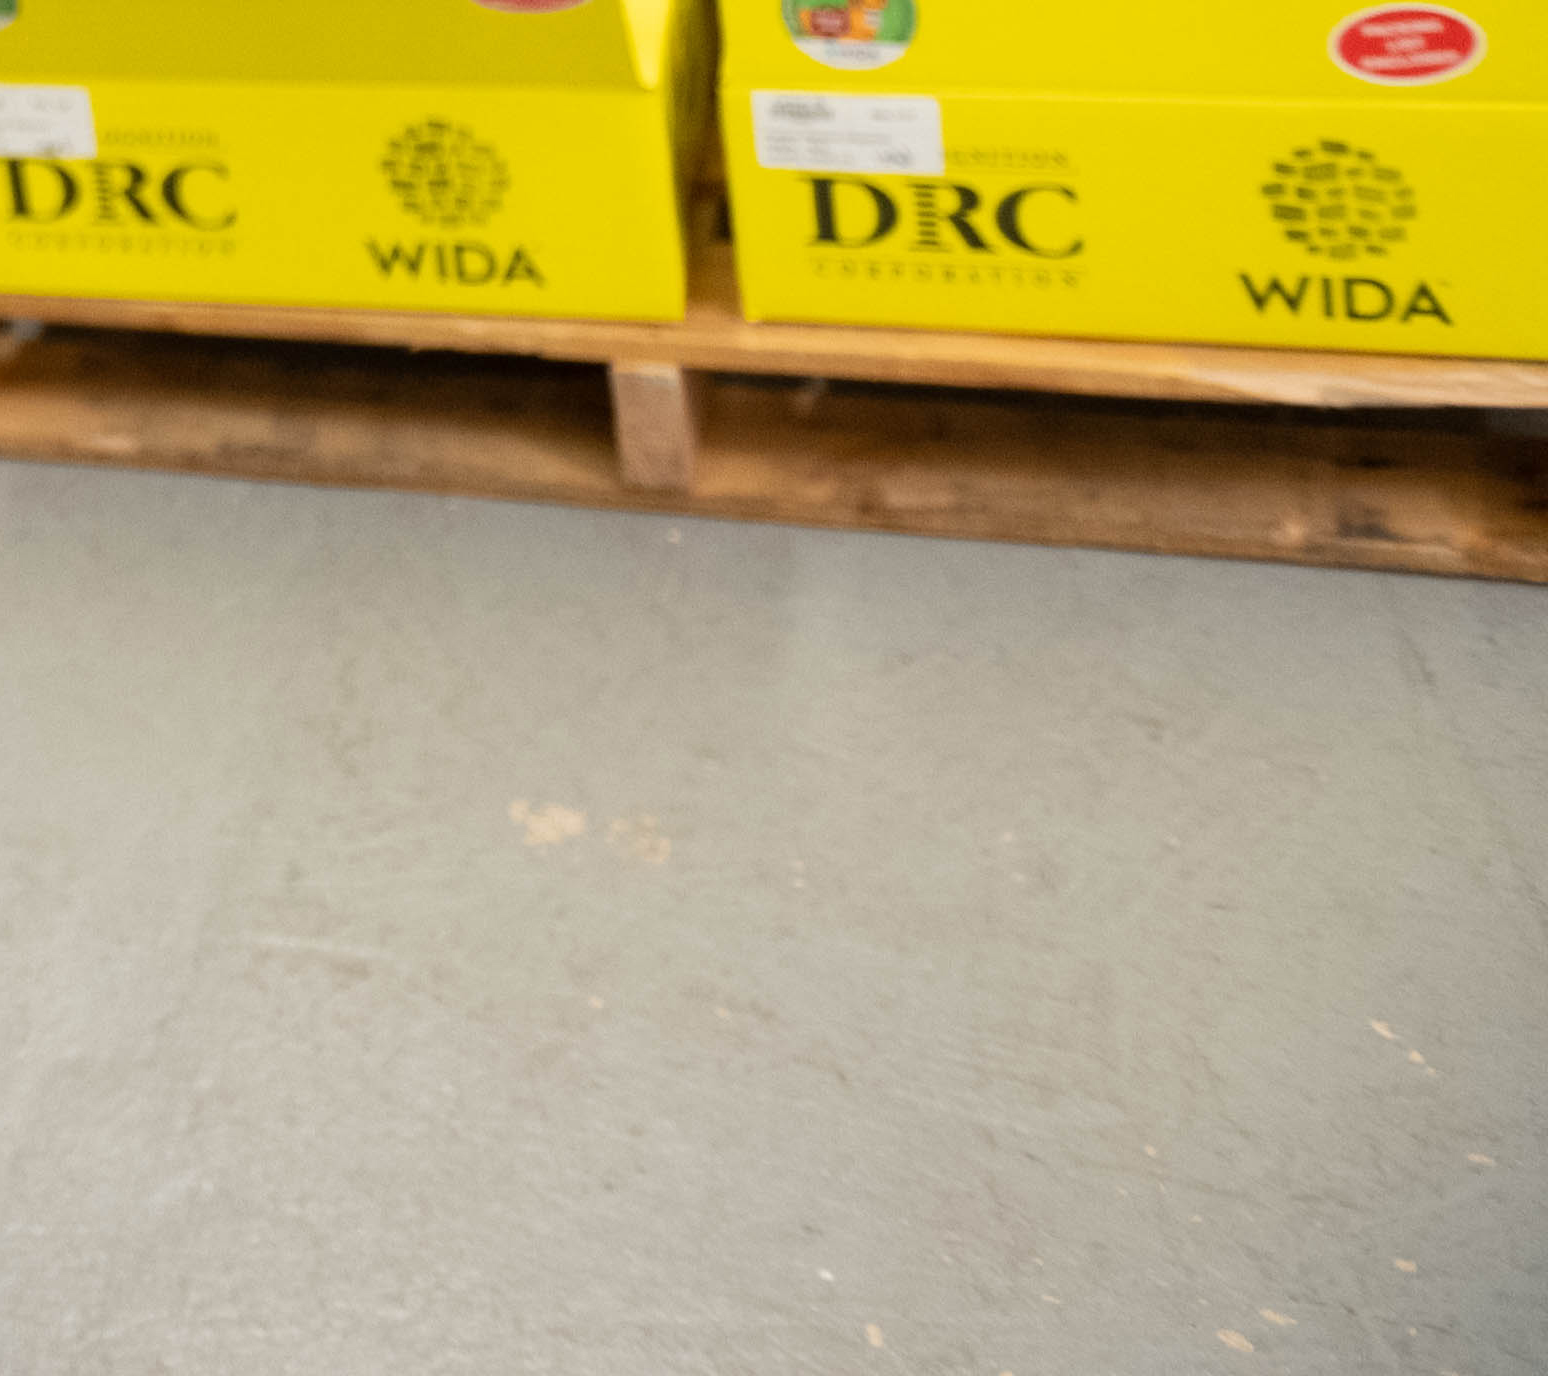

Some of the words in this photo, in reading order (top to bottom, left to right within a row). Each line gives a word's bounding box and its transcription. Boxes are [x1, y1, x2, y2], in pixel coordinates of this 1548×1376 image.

[796, 175, 1086, 261] DRC
[364, 235, 547, 290] WIDA
[1239, 271, 1454, 328] WIDA
